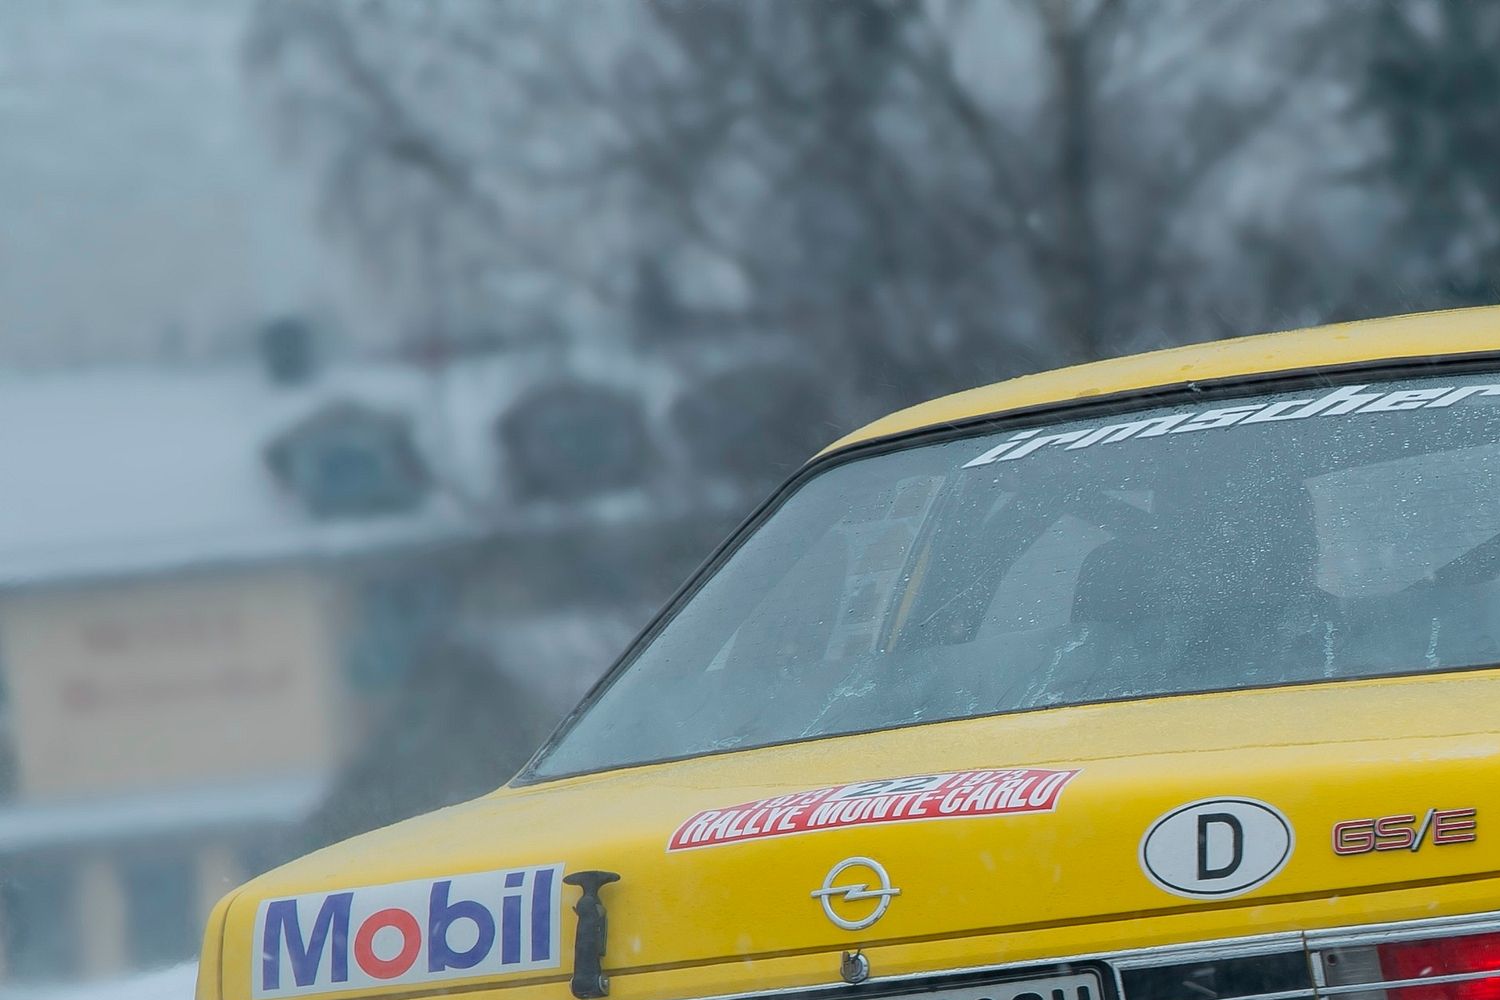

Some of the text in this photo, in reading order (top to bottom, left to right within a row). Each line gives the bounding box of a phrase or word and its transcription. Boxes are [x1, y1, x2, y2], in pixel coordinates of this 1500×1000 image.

[843, 776, 933, 798] 22
[945, 769, 1030, 788] 1973
[680, 772, 1071, 845] RALLYE MONTE-CARLO
[1332, 808, 1476, 855] GS/E
[1197, 813, 1243, 881] D
[262, 867, 554, 991] Mobil
